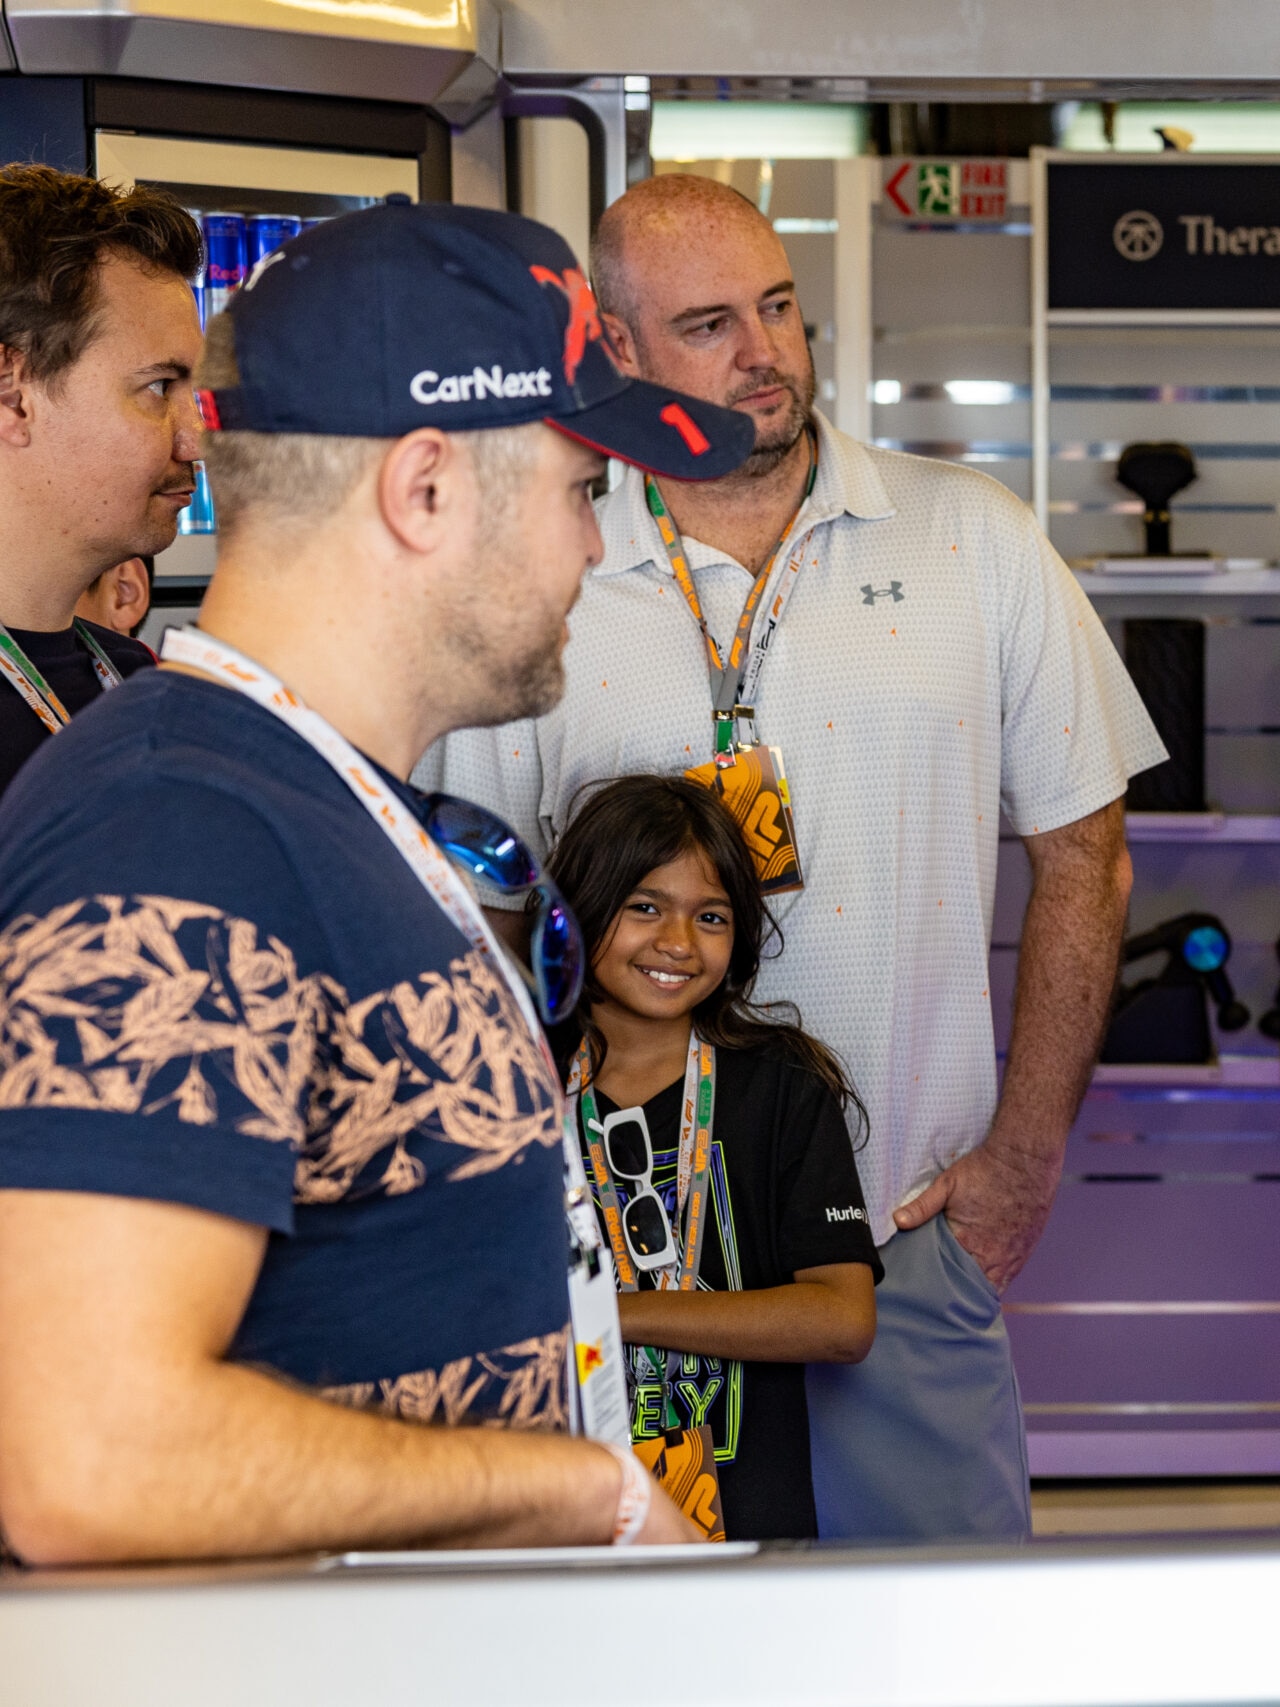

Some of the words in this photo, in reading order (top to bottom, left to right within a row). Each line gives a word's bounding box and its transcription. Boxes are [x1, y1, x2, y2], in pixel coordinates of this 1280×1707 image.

[961, 193, 1005, 217] EXIT
[410, 364, 552, 404] CarNext
[659, 402, 710, 456] 1
[604, 1206, 625, 1252] DHABI
[616, 1254, 634, 1285] ABU
